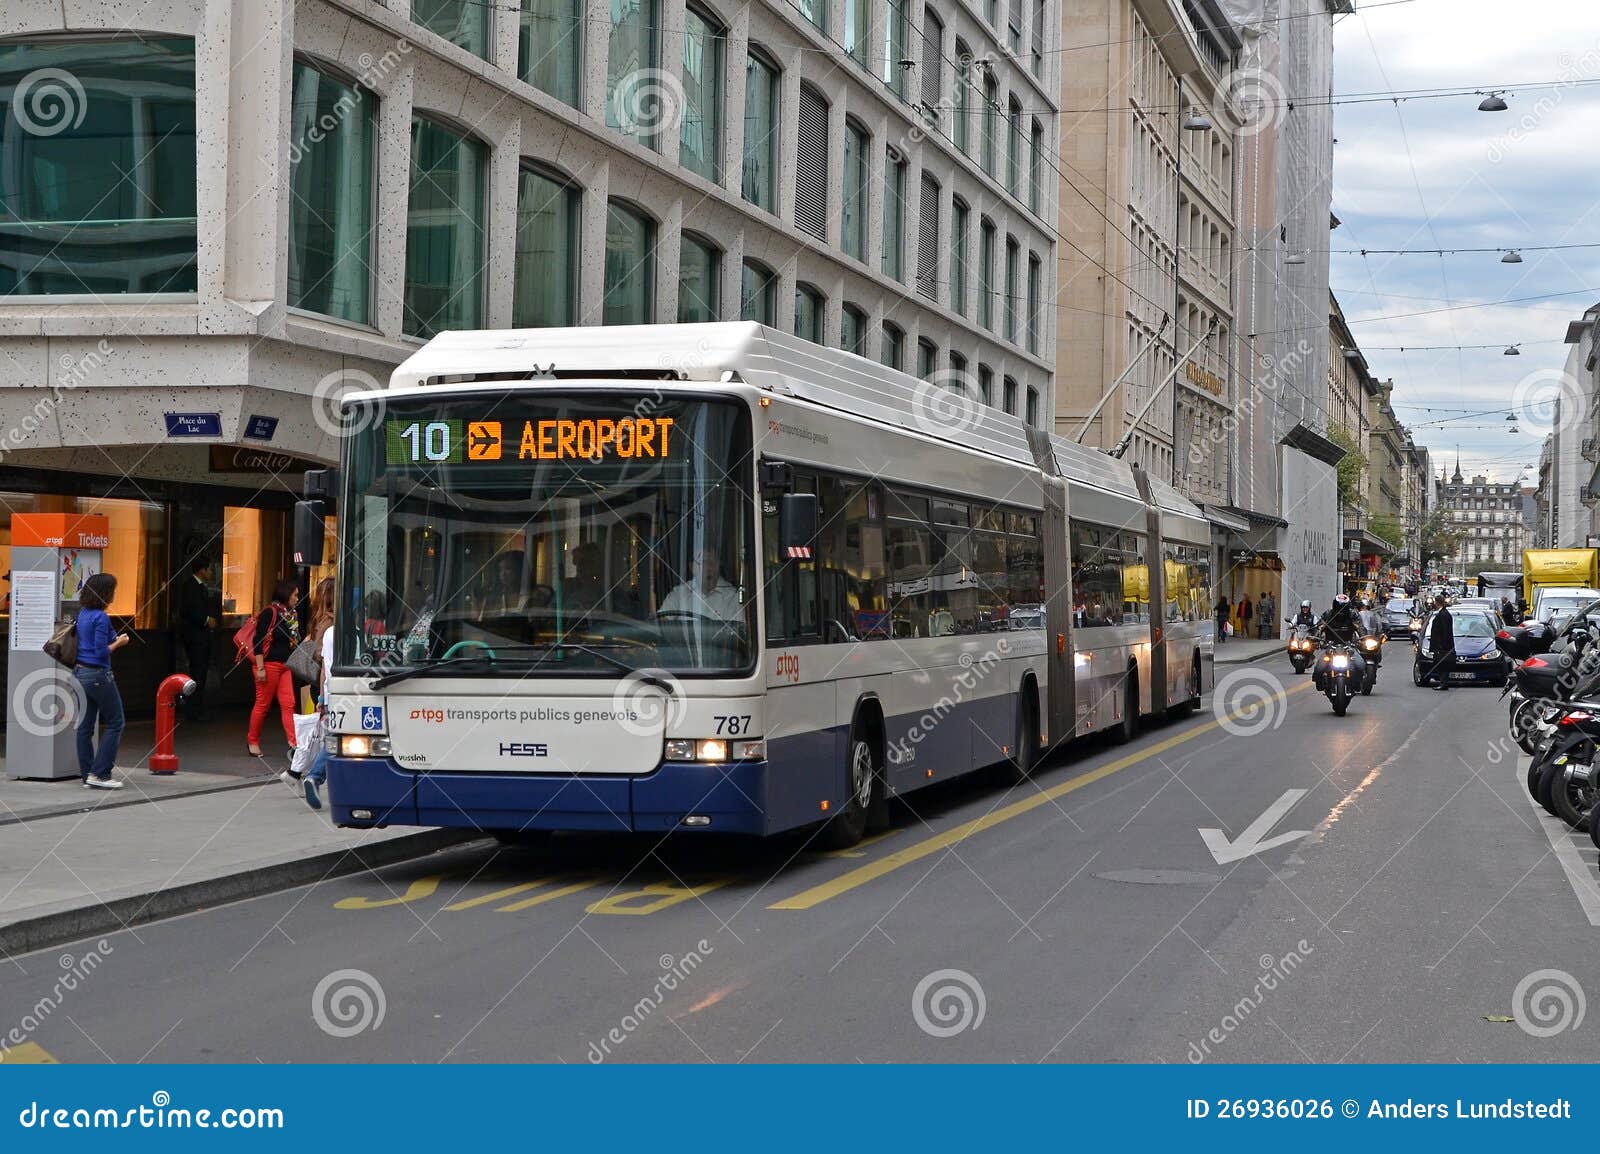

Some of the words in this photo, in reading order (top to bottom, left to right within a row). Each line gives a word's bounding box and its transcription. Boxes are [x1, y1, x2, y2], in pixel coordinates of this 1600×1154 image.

[179, 417, 197, 425] Place
[197, 416, 206, 424] du
[188, 425, 200, 433] Lac
[400, 421, 450, 461] 10
[519, 417, 674, 459] AEROPORT
[78, 532, 109, 547] Tickets
[327, 711, 345, 729] 87
[447, 708, 517, 723] transports
[520, 708, 570, 724] publics
[574, 709, 638, 724] genevois
[713, 715, 752, 735] 787
[499, 743, 548, 757] HESS
